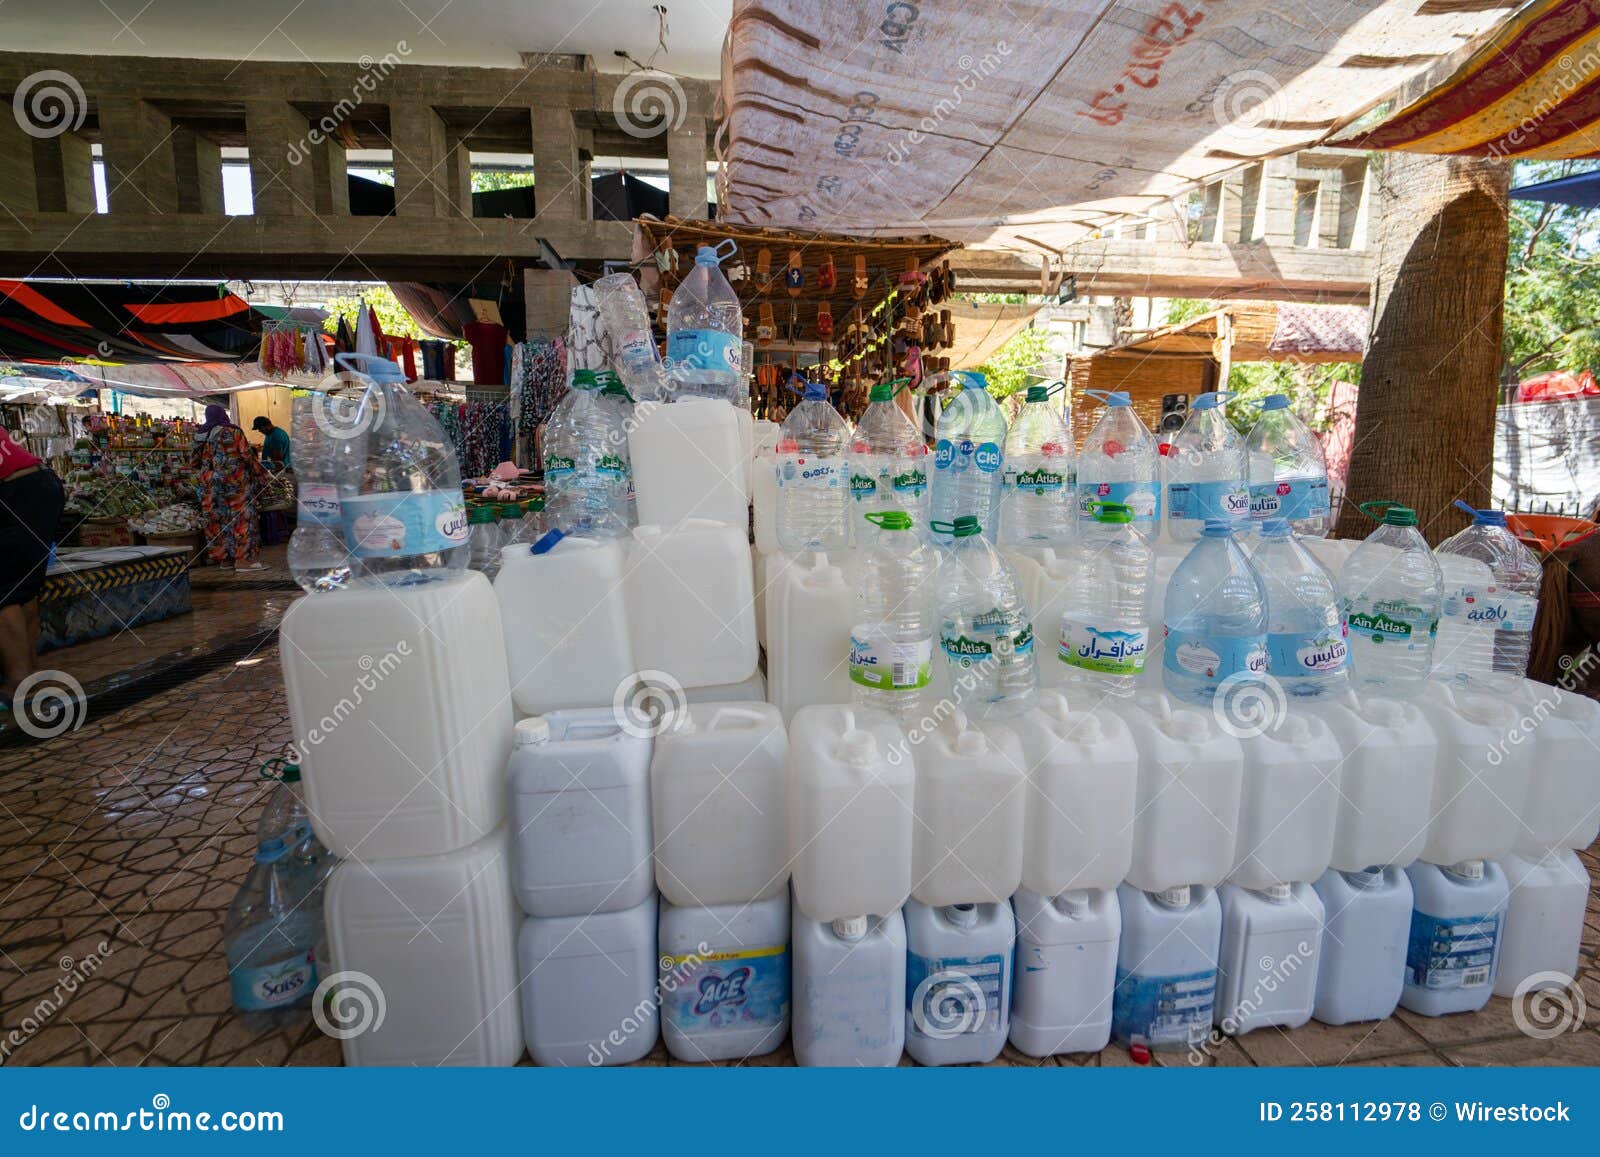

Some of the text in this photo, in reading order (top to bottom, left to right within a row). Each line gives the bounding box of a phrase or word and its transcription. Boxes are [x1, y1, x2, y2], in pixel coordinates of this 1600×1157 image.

[1036, 474, 1059, 484] Atlas
[1374, 618, 1406, 633] Atlas
[960, 641, 987, 654] Atlas
[1078, 637, 1144, 662] عين إفران
[1303, 645, 1346, 667] سايس
[700, 975, 743, 1004] ACE
